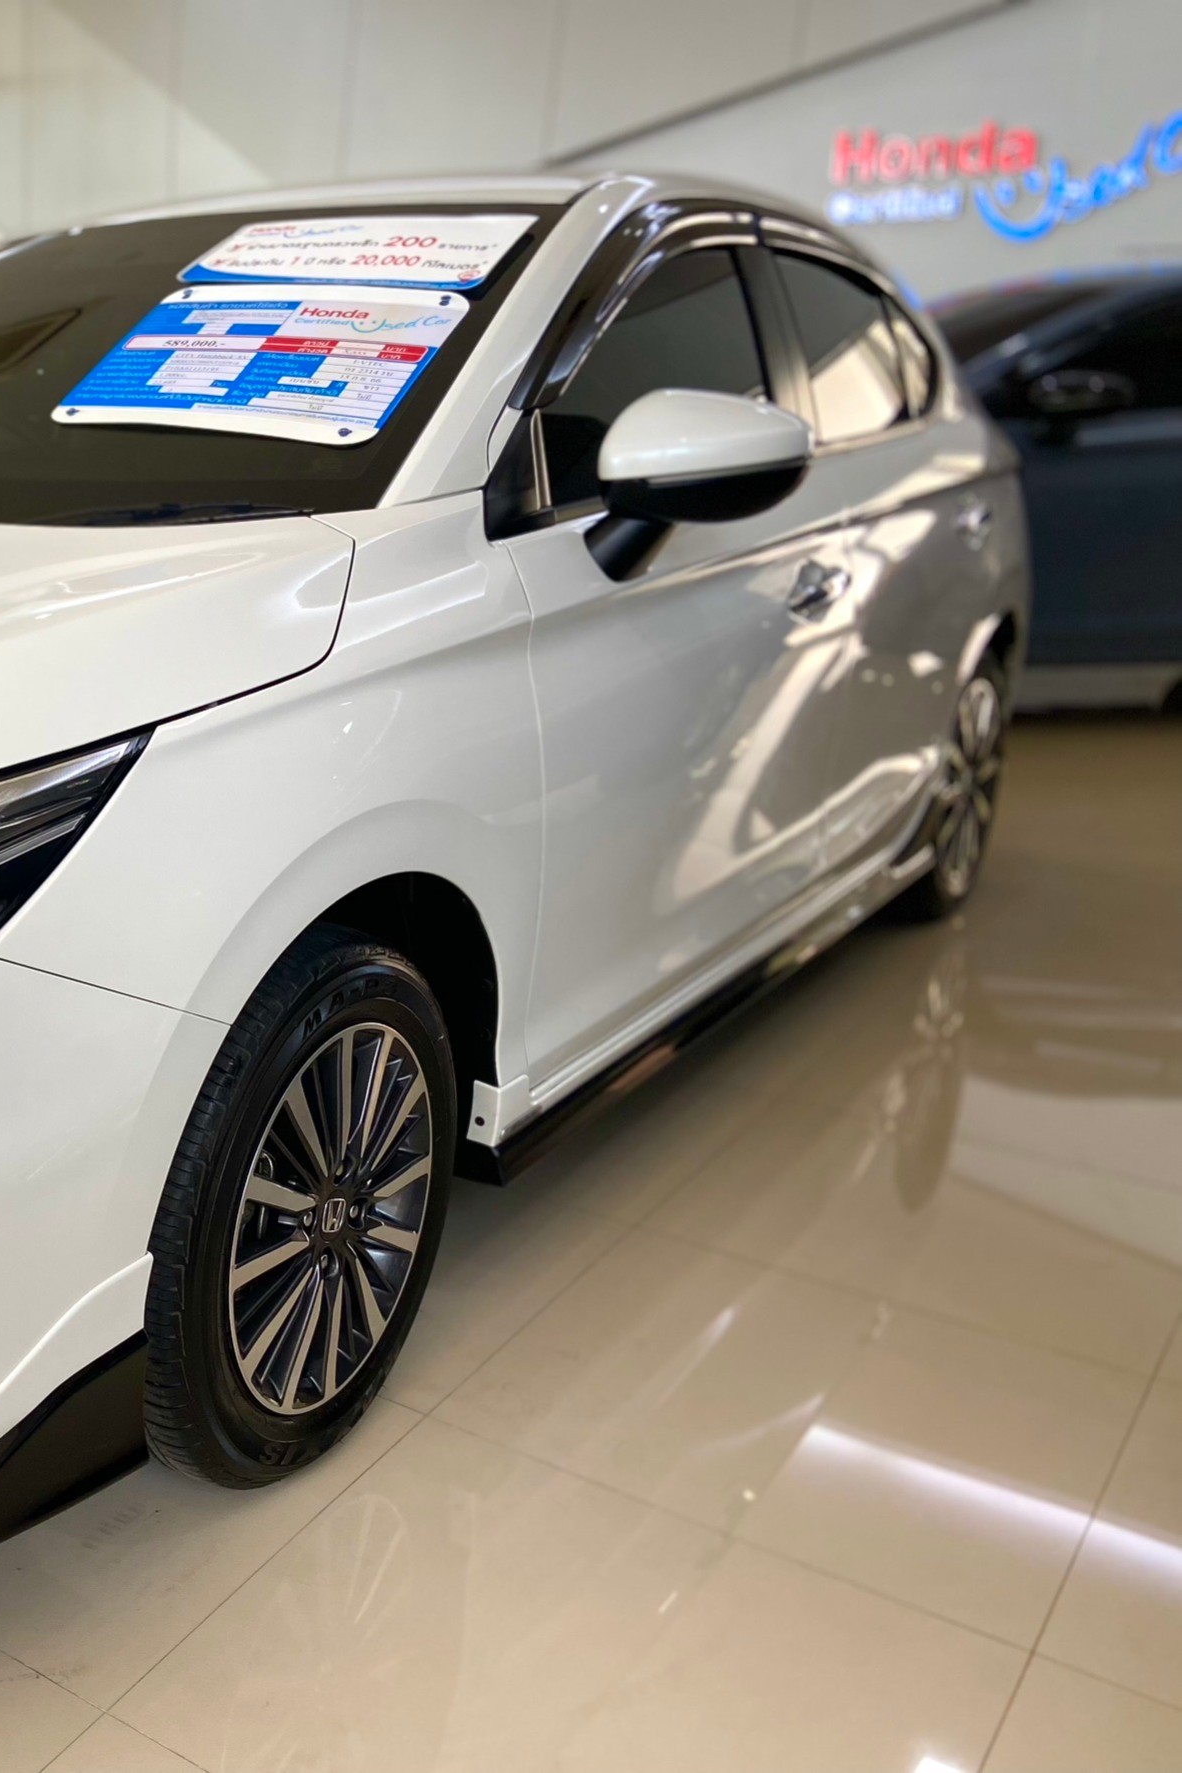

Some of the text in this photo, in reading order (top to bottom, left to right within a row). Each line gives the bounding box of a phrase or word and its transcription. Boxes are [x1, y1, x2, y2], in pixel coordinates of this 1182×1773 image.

[831, 118, 1039, 184] Honda
[382, 236, 439, 248] 200
[289, 256, 300, 265] 1
[349, 254, 421, 268] 20,000
[299, 307, 370, 320] Honda
[294, 317, 353, 327] Certified
